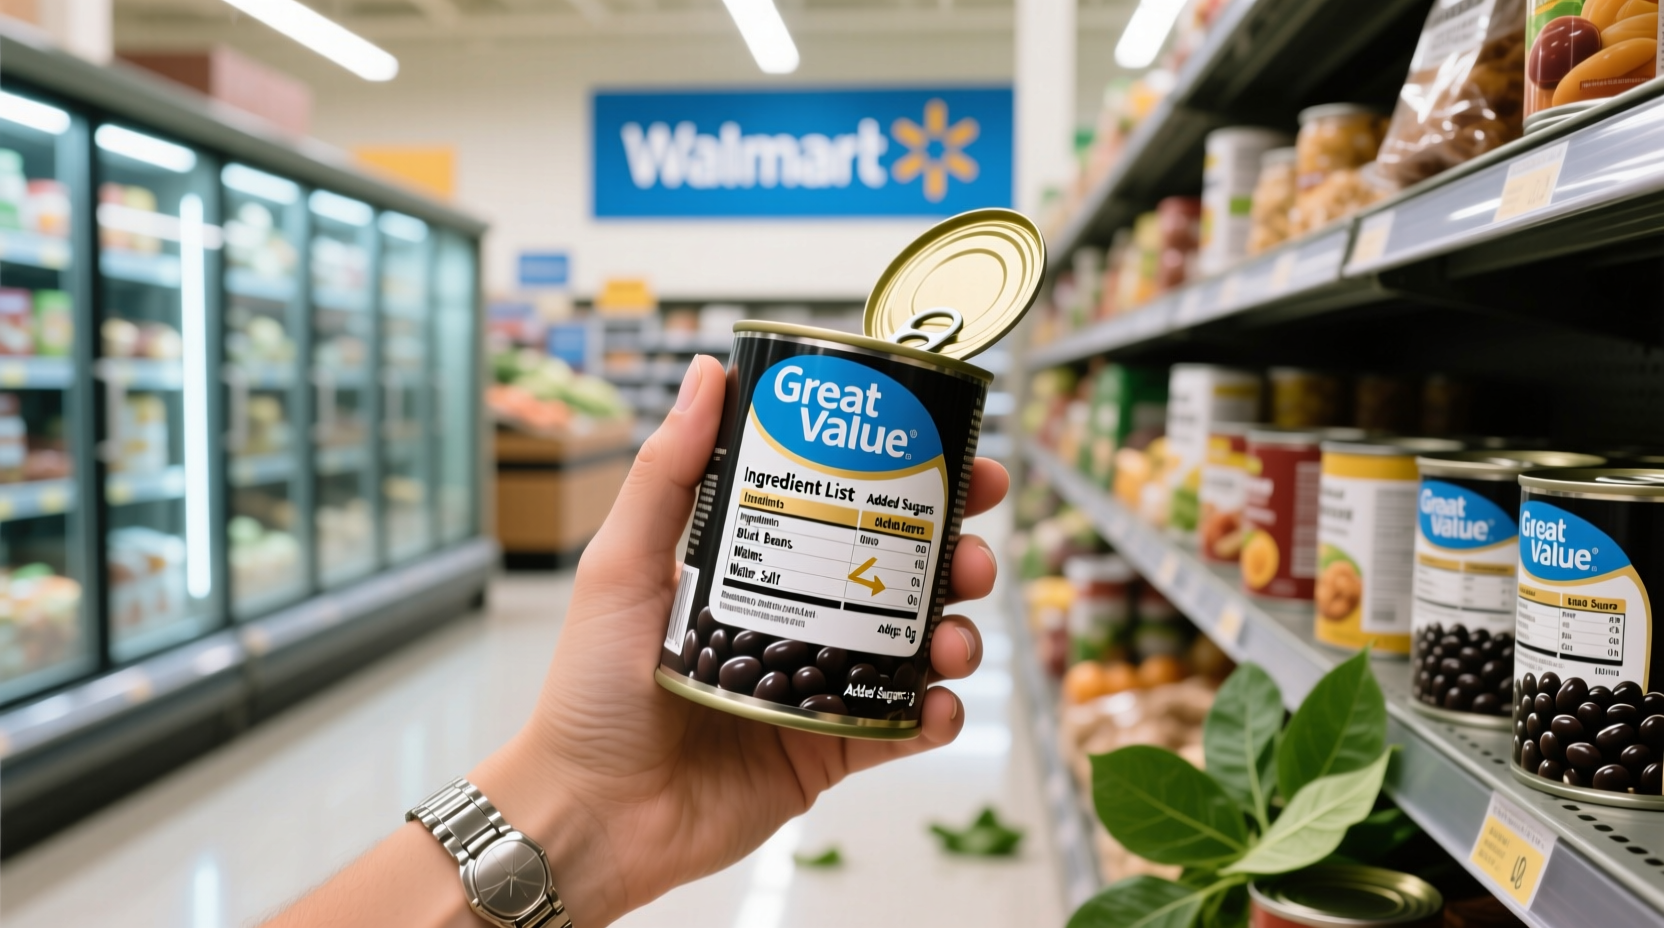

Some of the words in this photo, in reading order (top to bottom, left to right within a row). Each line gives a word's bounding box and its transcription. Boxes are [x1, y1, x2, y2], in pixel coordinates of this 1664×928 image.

[619, 116, 889, 190] Walmart
[774, 365, 882, 418] Great
[744, 466, 822, 496] Ingredient
[825, 481, 855, 502] List
[866, 493, 900, 509] Added
[1420, 488, 1467, 518] Great
[1521, 510, 1567, 543] Great
